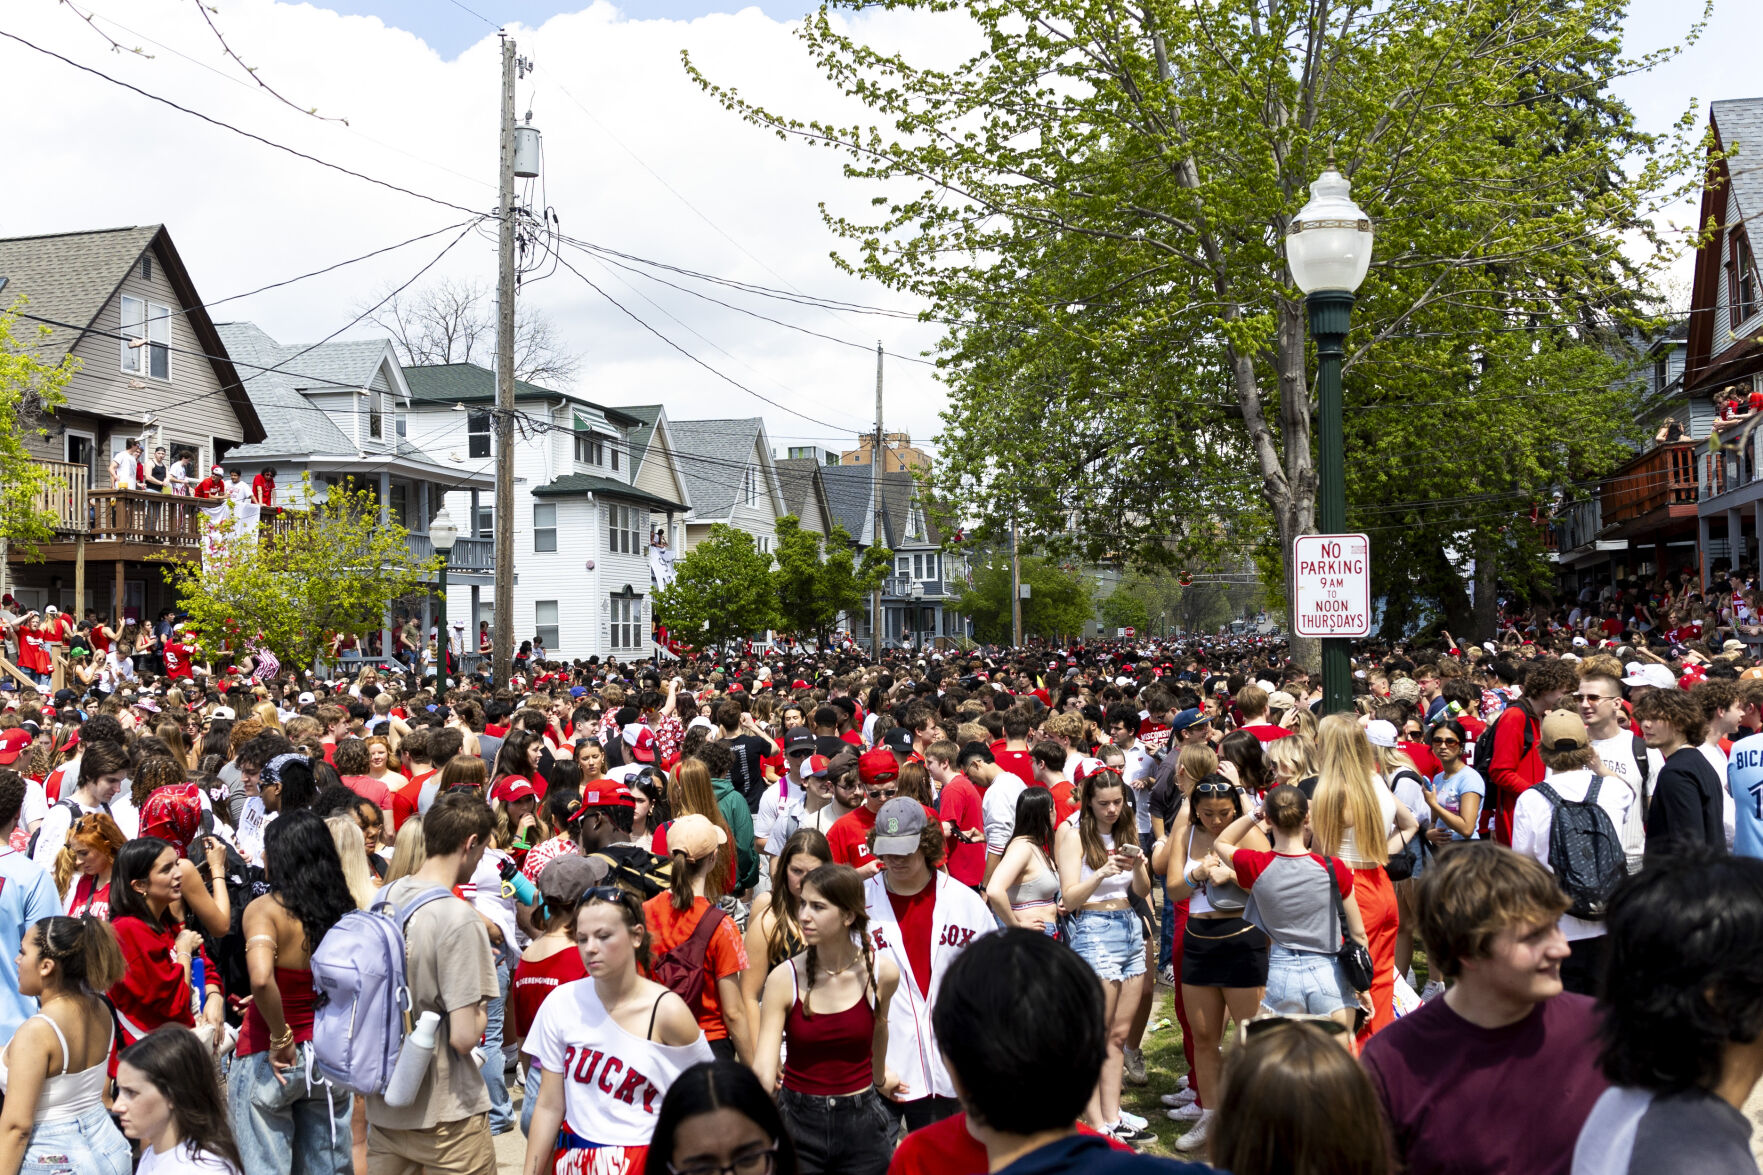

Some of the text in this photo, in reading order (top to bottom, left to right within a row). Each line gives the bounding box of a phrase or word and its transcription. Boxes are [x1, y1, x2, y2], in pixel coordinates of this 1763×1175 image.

[1321, 543, 1341, 559] NO
[1300, 560, 1363, 575] PARKING
[1320, 577, 1344, 589] 9 AM
[1327, 590, 1337, 599] TO
[1316, 600, 1348, 612] NOON
[1301, 613, 1364, 628] THURSDAYS
[887, 817, 900, 834] B
